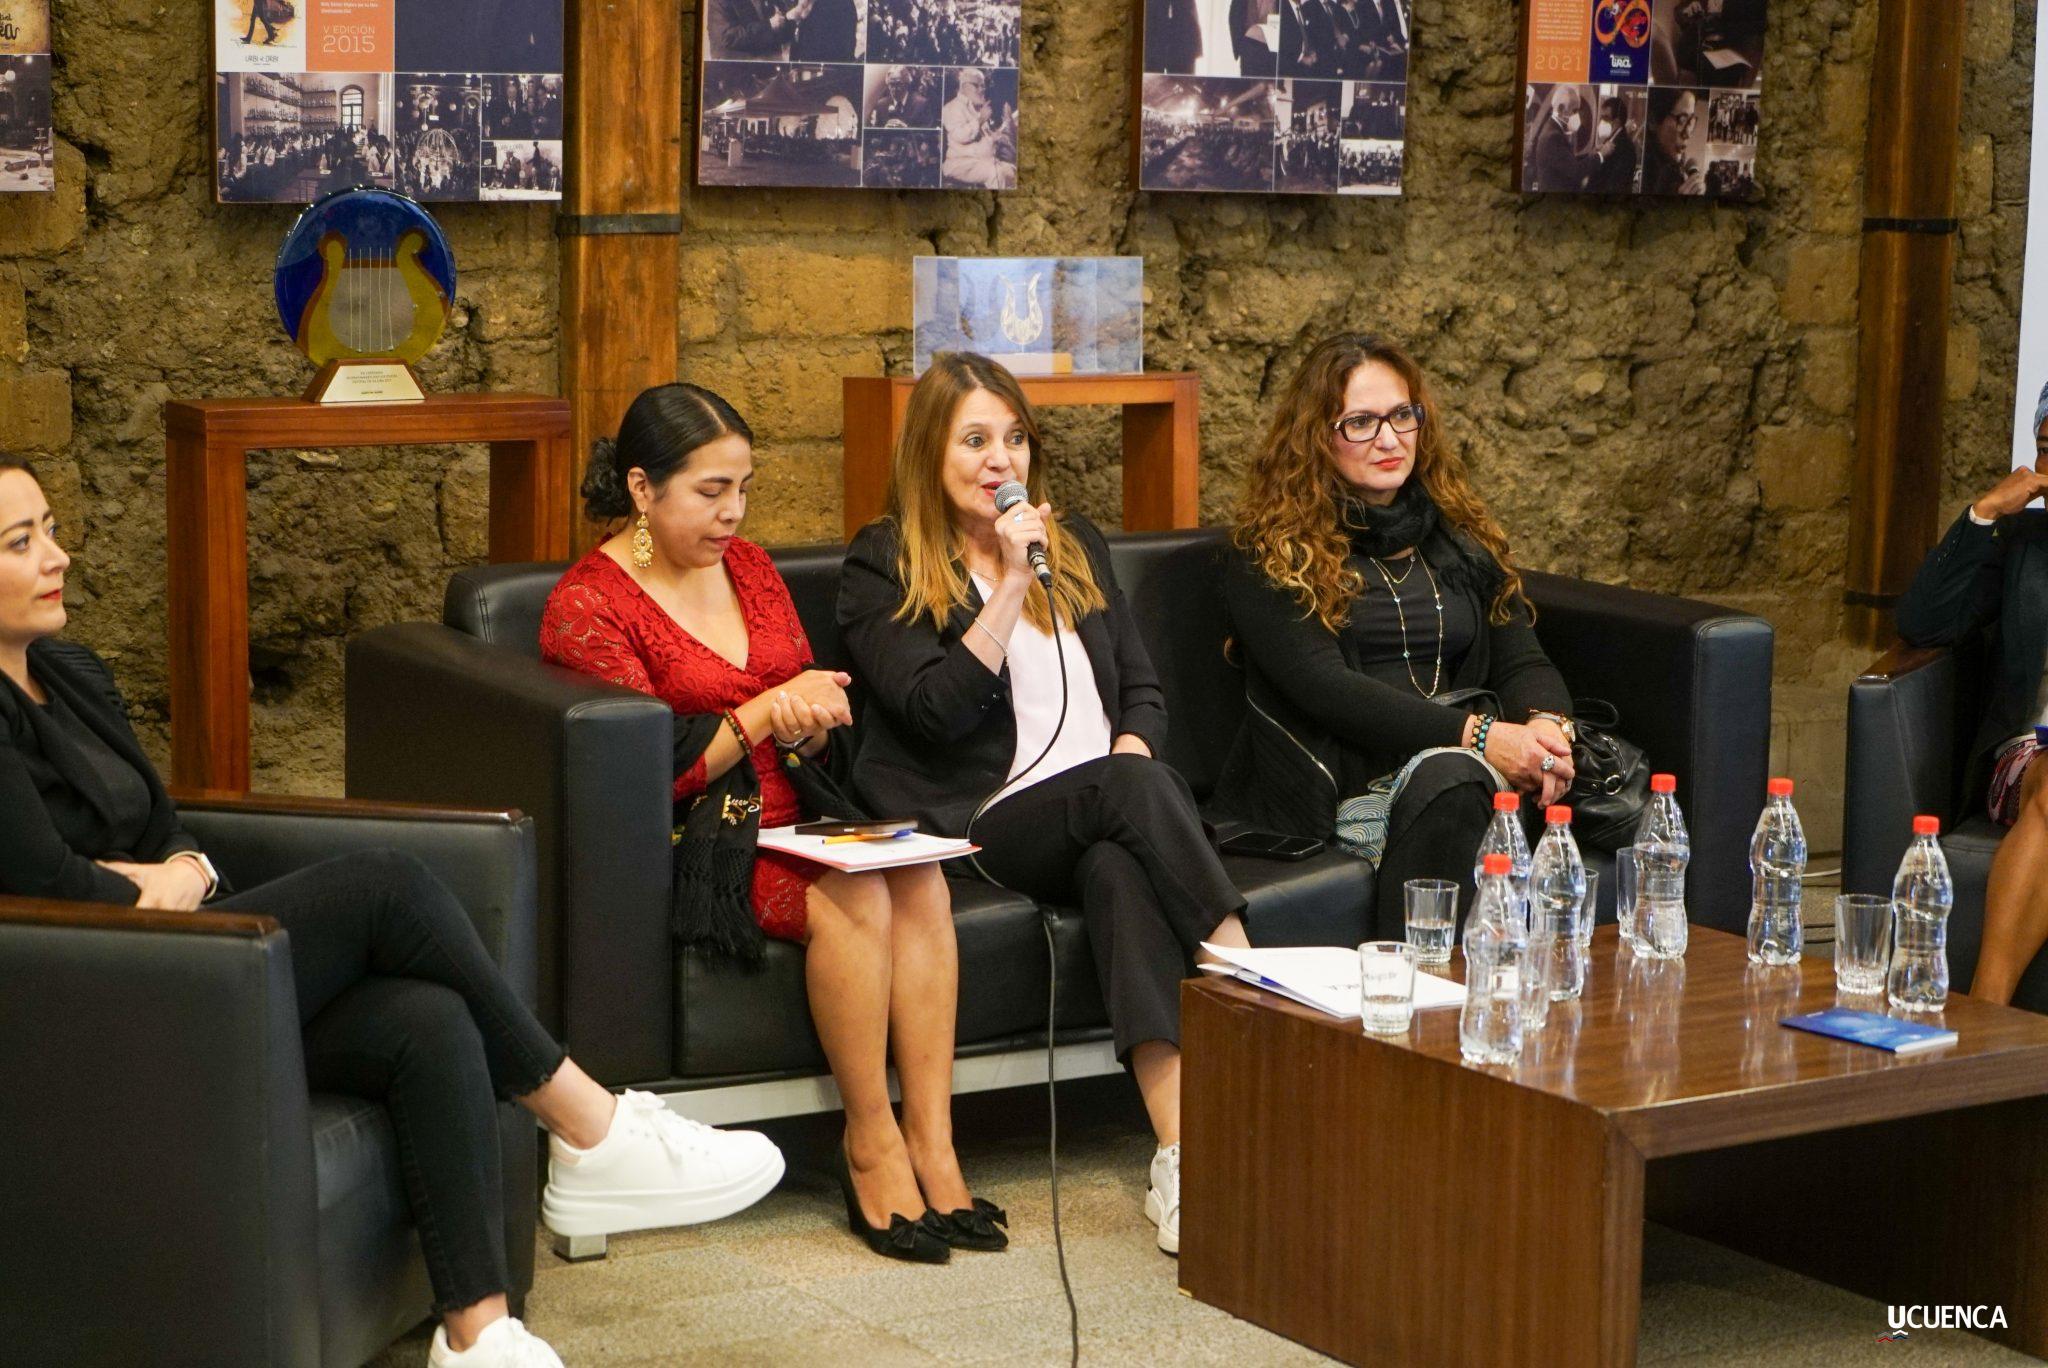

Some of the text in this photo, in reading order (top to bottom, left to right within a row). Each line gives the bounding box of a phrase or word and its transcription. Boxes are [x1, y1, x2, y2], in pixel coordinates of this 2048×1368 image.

[323, 25, 330, 34] V
[323, 35, 376, 53] 2015
[1534, 55, 1582, 71] 2021
